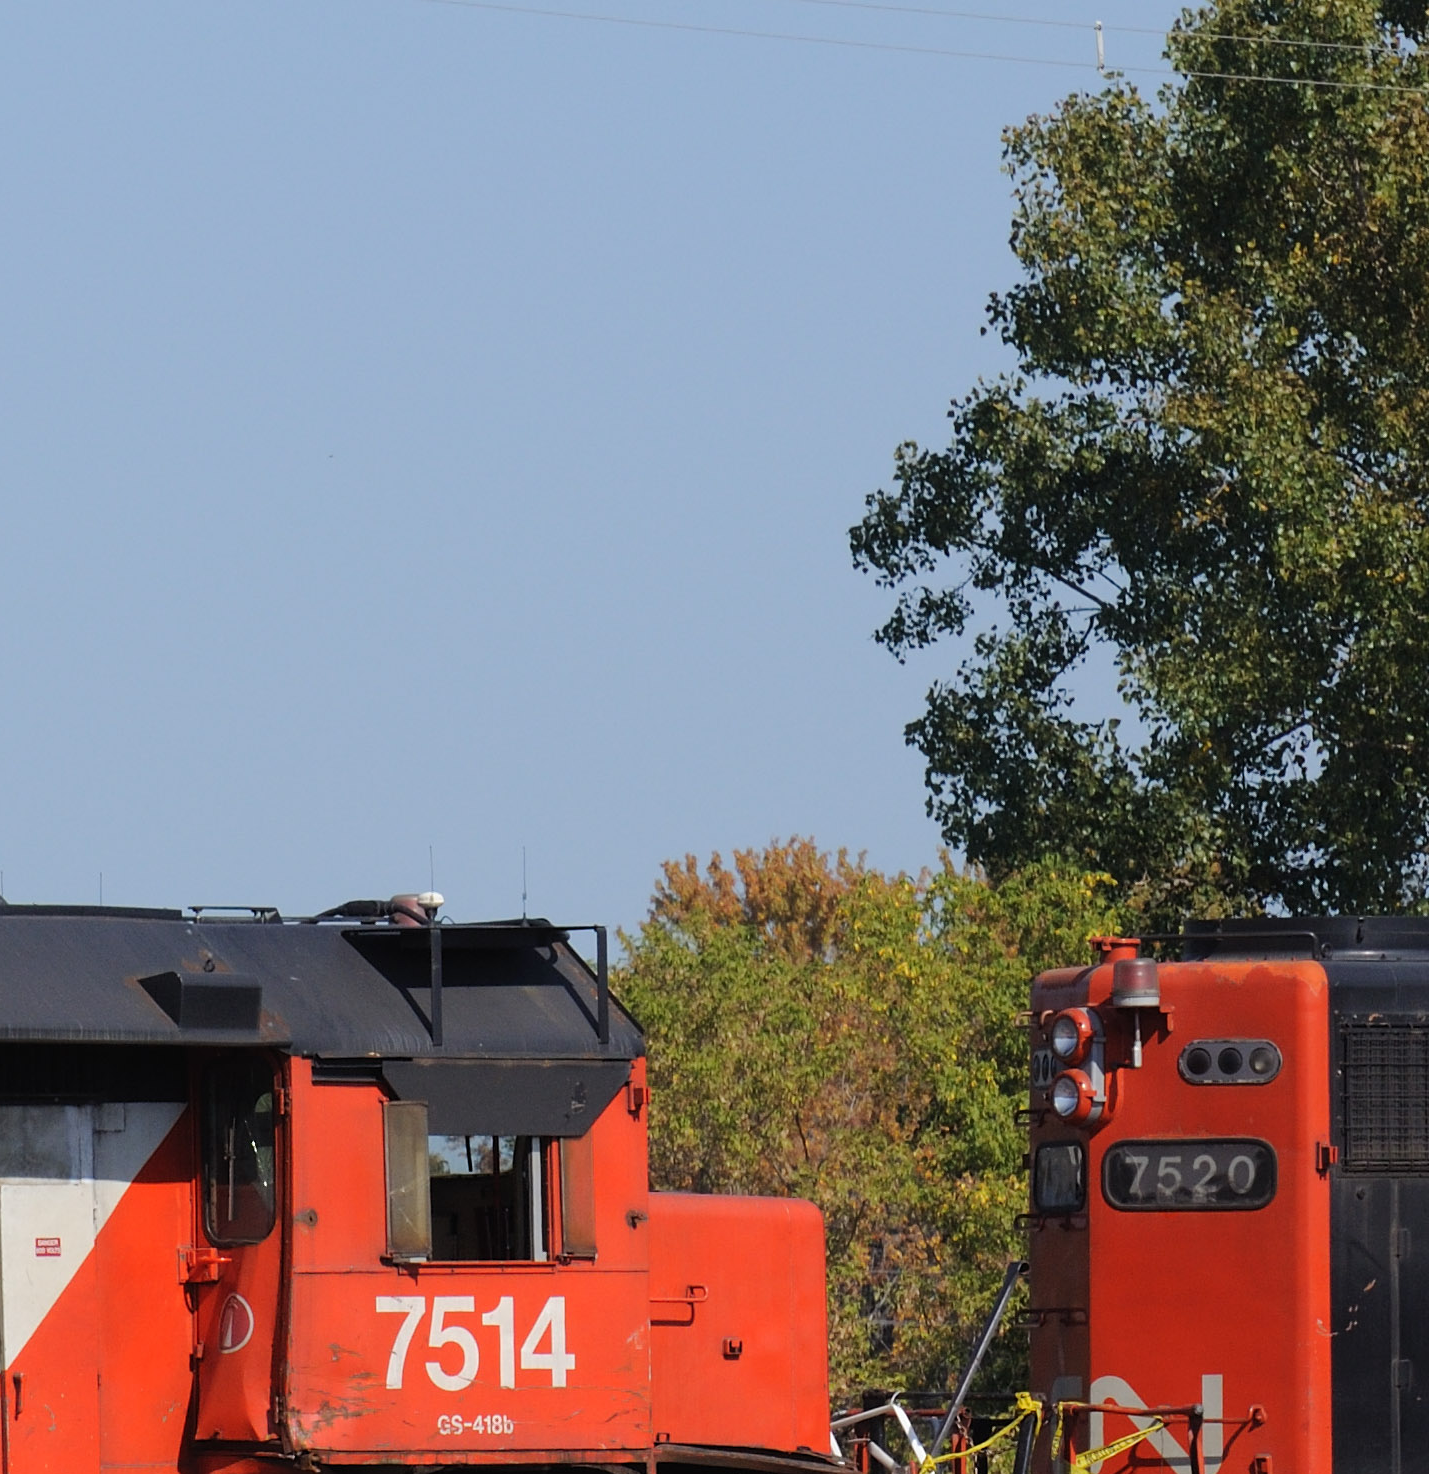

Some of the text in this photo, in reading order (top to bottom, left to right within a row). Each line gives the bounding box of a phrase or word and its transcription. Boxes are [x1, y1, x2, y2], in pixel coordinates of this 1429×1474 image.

[1125, 1154, 1256, 1196] 7520
[374, 1295, 577, 1391] 7514
[437, 1414, 514, 1435] GS-418b
